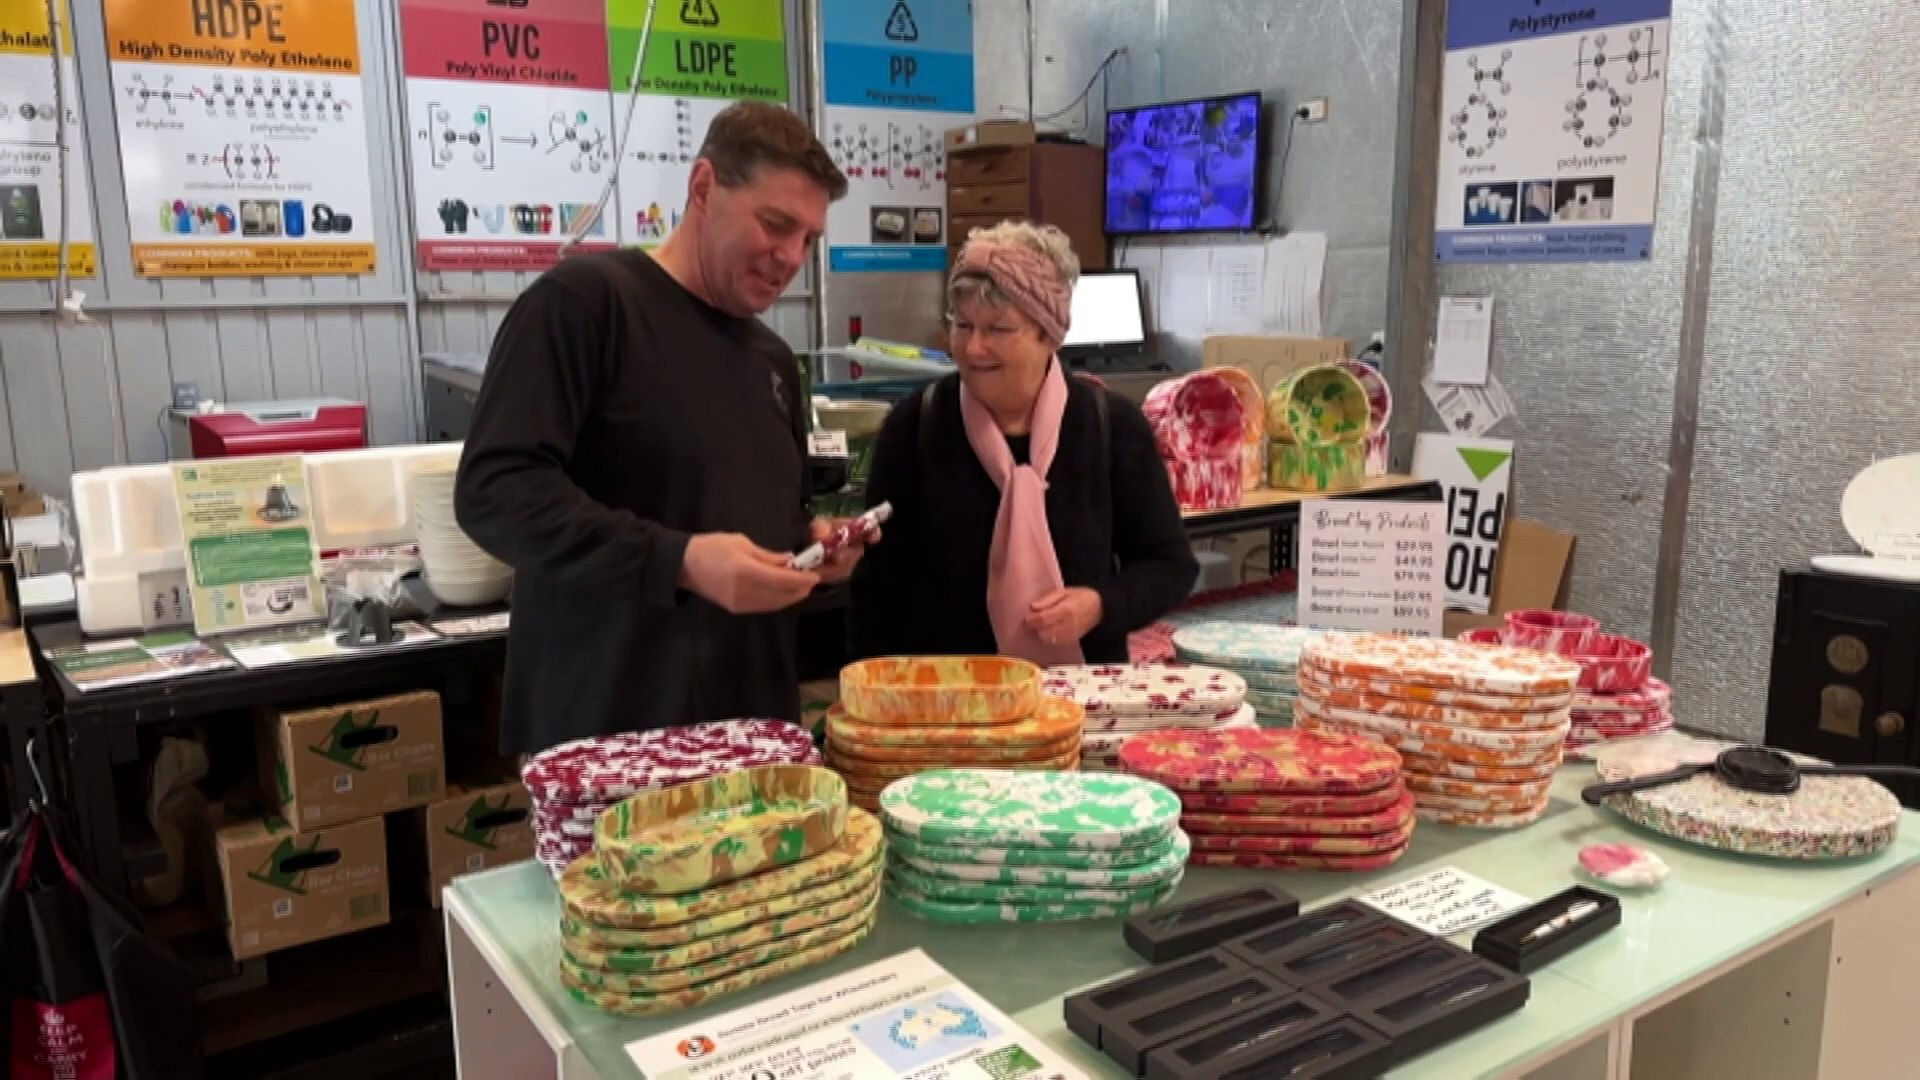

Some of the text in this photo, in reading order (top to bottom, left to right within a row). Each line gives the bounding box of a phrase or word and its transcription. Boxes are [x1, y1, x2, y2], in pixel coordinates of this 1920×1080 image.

[192, 0, 286, 43] HDPE
[1510, 8, 1596, 32] Polystyrene
[119, 40, 163, 59] High
[168, 42, 236, 65] Density
[240, 49, 276, 67] Poly
[482, 20, 540, 60] PVC
[446, 61, 578, 81] Poly Vinyl Chloride
[675, 39, 737, 76] LDPE
[890, 55, 917, 88] PP
[1557, 154, 1628, 171] polystyrene
